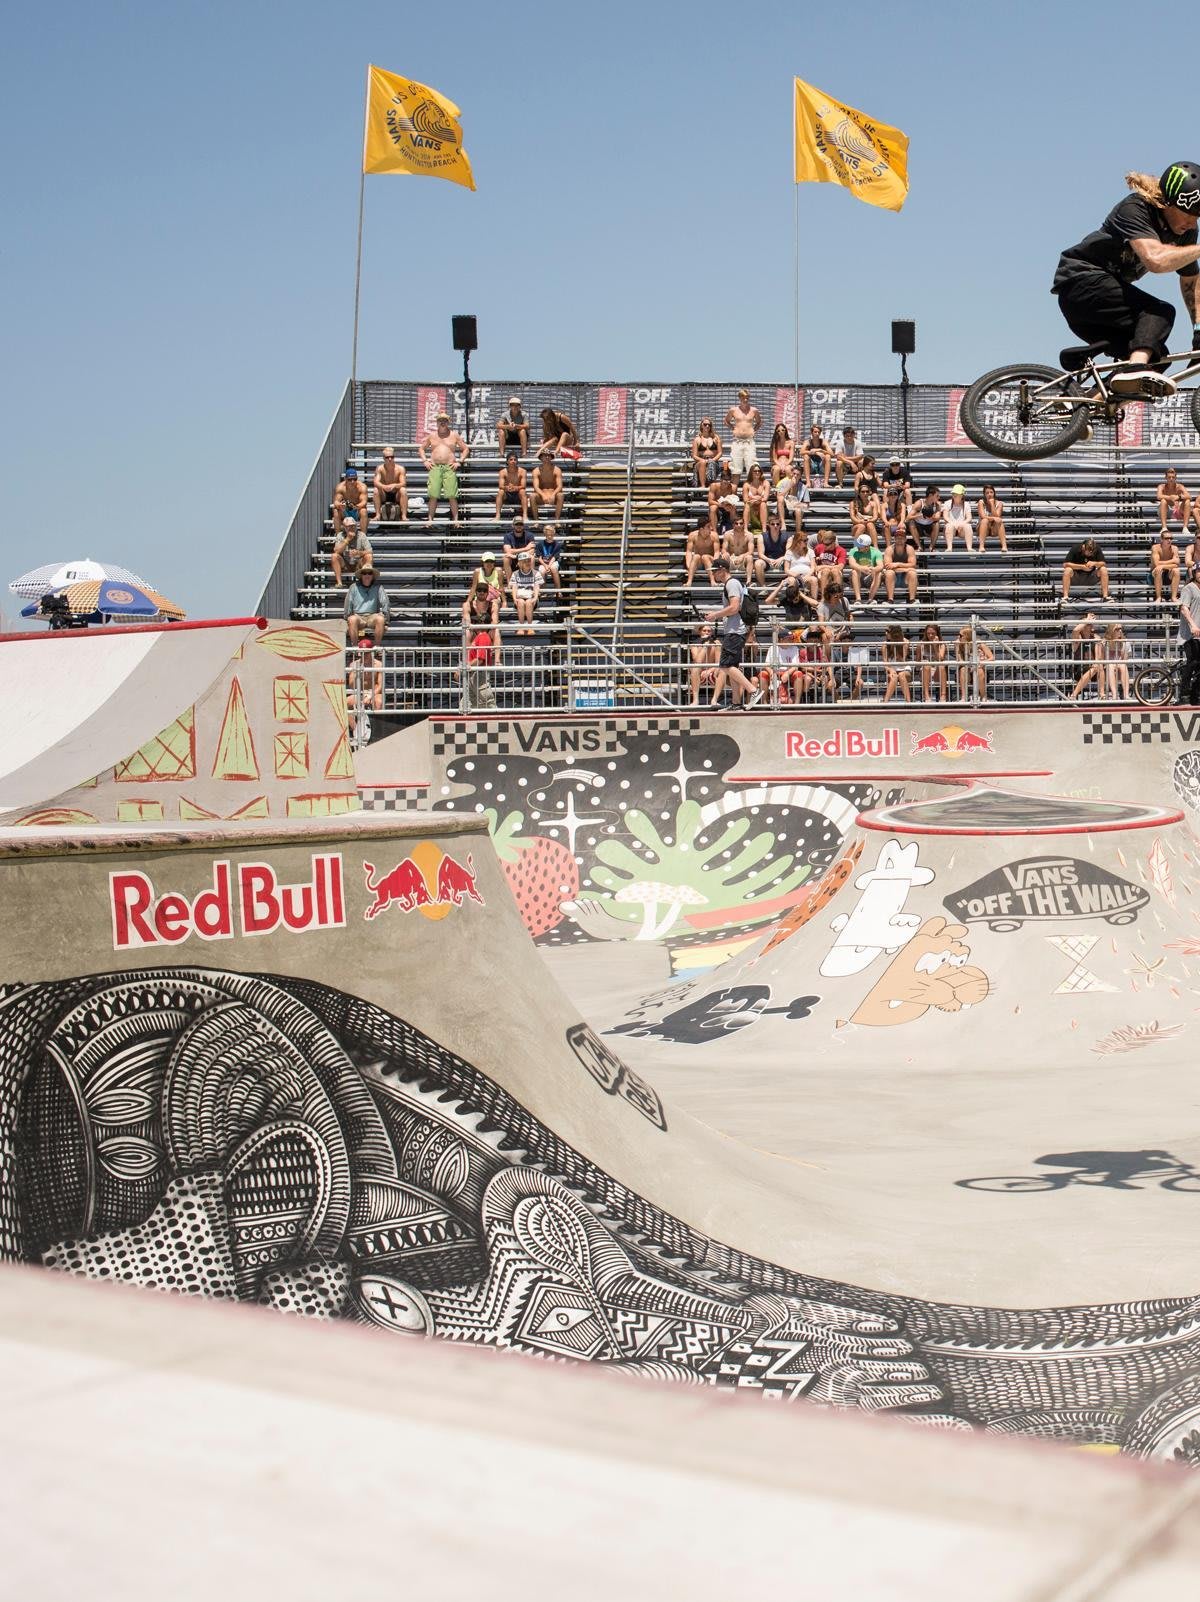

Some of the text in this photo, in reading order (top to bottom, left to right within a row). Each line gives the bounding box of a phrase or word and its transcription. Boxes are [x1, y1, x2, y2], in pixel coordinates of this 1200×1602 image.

[409, 133, 443, 152] VANS
[838, 149, 862, 170] ANS
[633, 408, 670, 424] THE
[811, 408, 848, 425] THE
[1151, 411, 1186, 428] THE
[512, 721, 601, 752] VANS
[785, 728, 899, 758] Red Bull
[1001, 859, 1080, 891] VANS
[111, 856, 344, 946] Red Bull
[1014, 885, 1075, 916] THE
